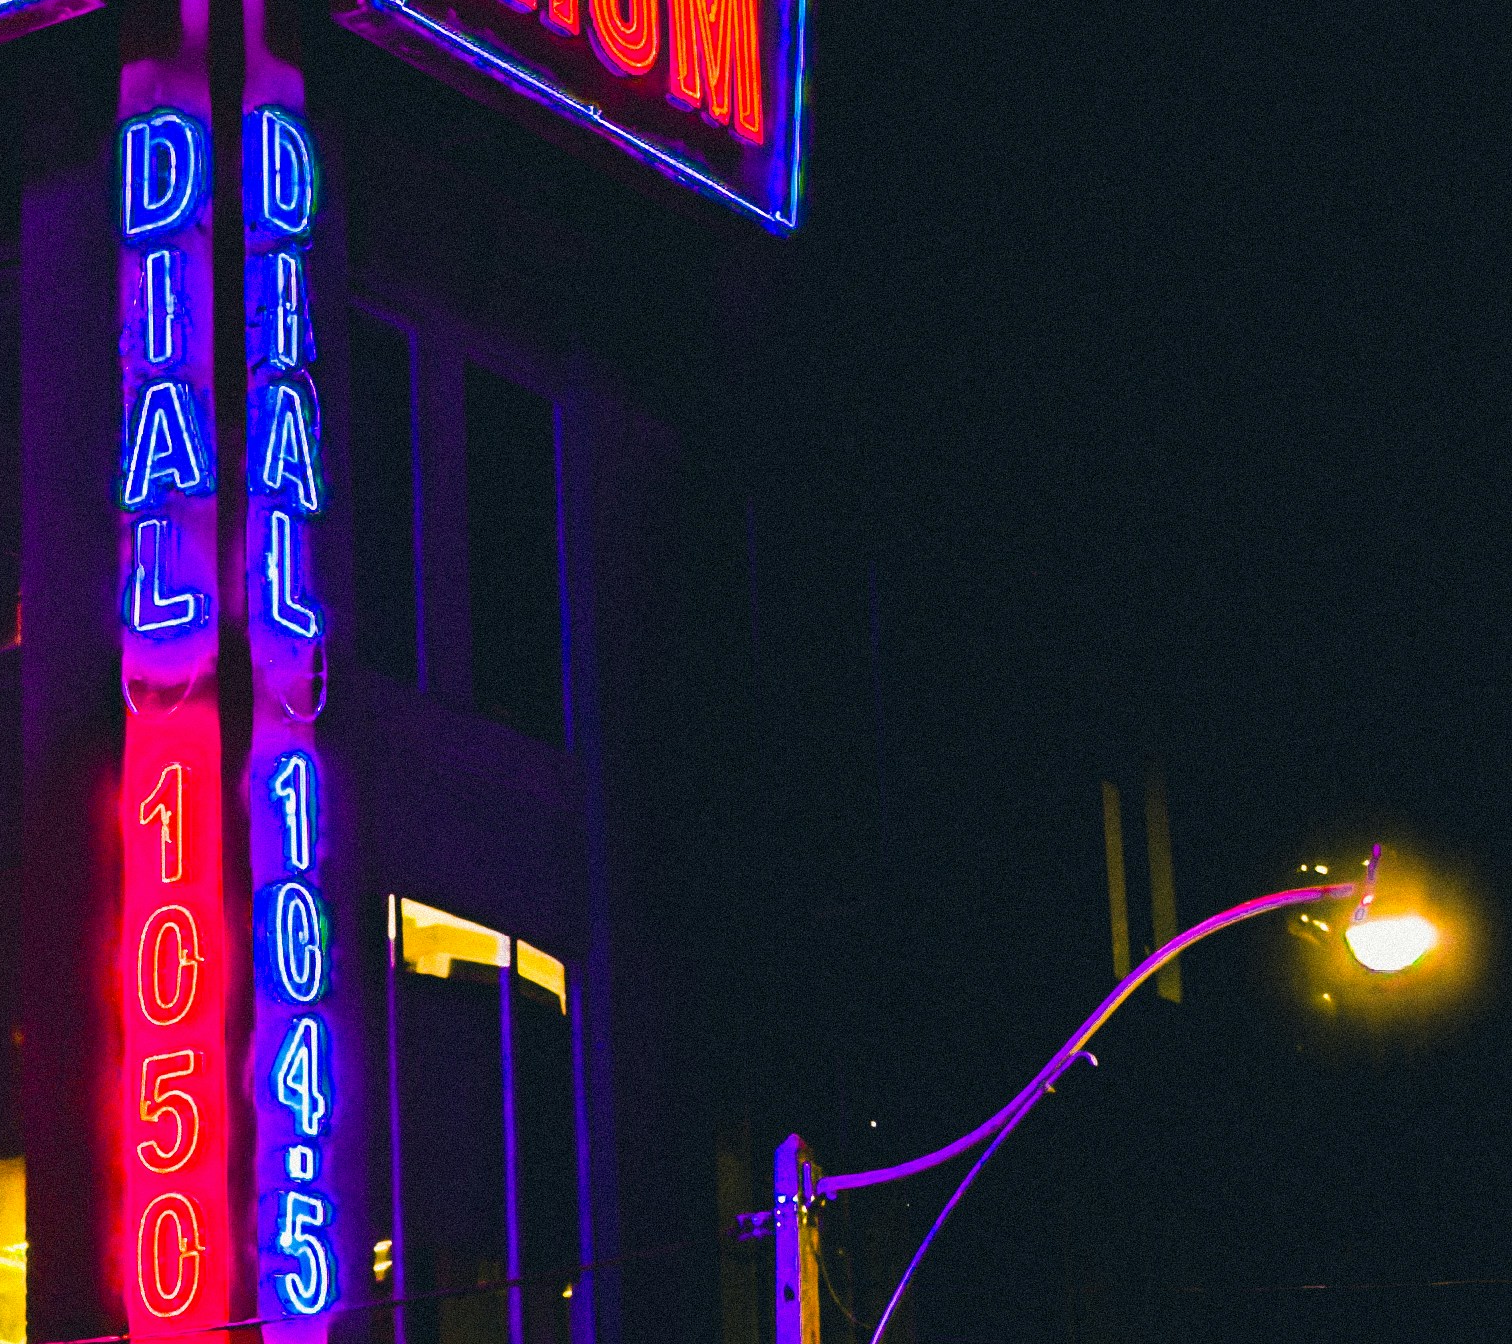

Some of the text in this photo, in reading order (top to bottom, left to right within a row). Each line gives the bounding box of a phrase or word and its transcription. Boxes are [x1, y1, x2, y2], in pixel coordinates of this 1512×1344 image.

[122, 111, 206, 1318] DIAL 1050
[258, 108, 329, 1316] DIAL 104.5
